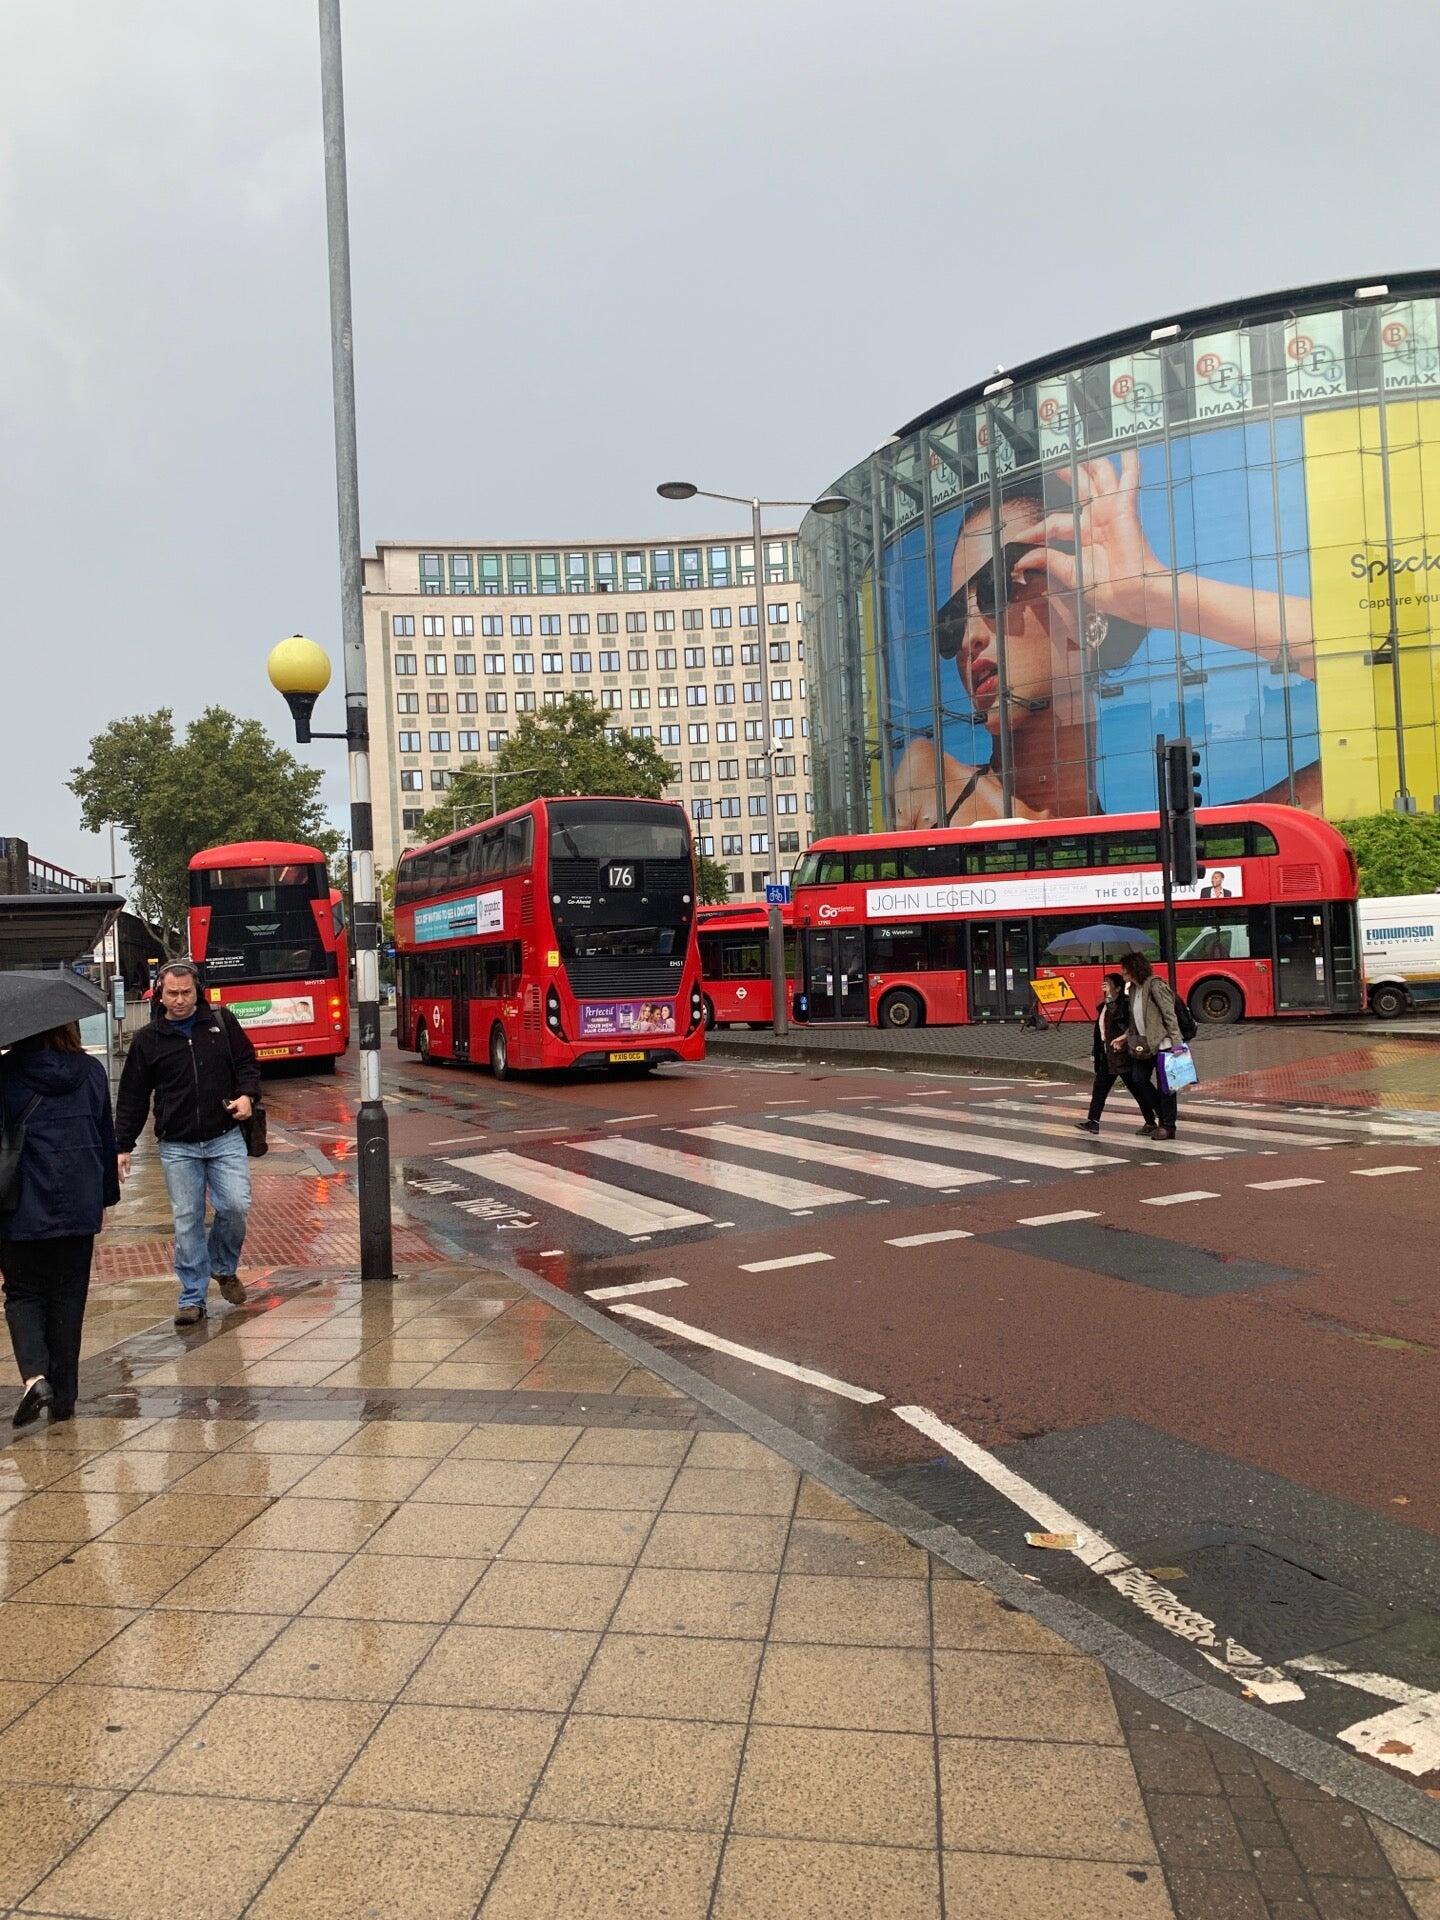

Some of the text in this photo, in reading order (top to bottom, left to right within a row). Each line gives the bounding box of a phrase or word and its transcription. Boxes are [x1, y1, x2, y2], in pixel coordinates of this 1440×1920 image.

[1385, 372, 1437, 388] IMAX
[1290, 383, 1344, 400] IMAX
[1199, 398, 1249, 417] IMAX
[1115, 416, 1162, 437] IMAX
[1415, 594, 1440, 606] you
[609, 867, 632, 886] 176
[1096, 887, 1118, 898] THE
[1145, 884, 1196, 896] LODON
[871, 888, 997, 912] JOHN LEGEND
[881, 929, 891, 937] 76
[1366, 937, 1435, 946] ELECTRICAL
[228, 1003, 267, 1016] Pregnacare
[585, 1006, 615, 1018] Perfectil
[451, 1197, 532, 1221] RIGHT
